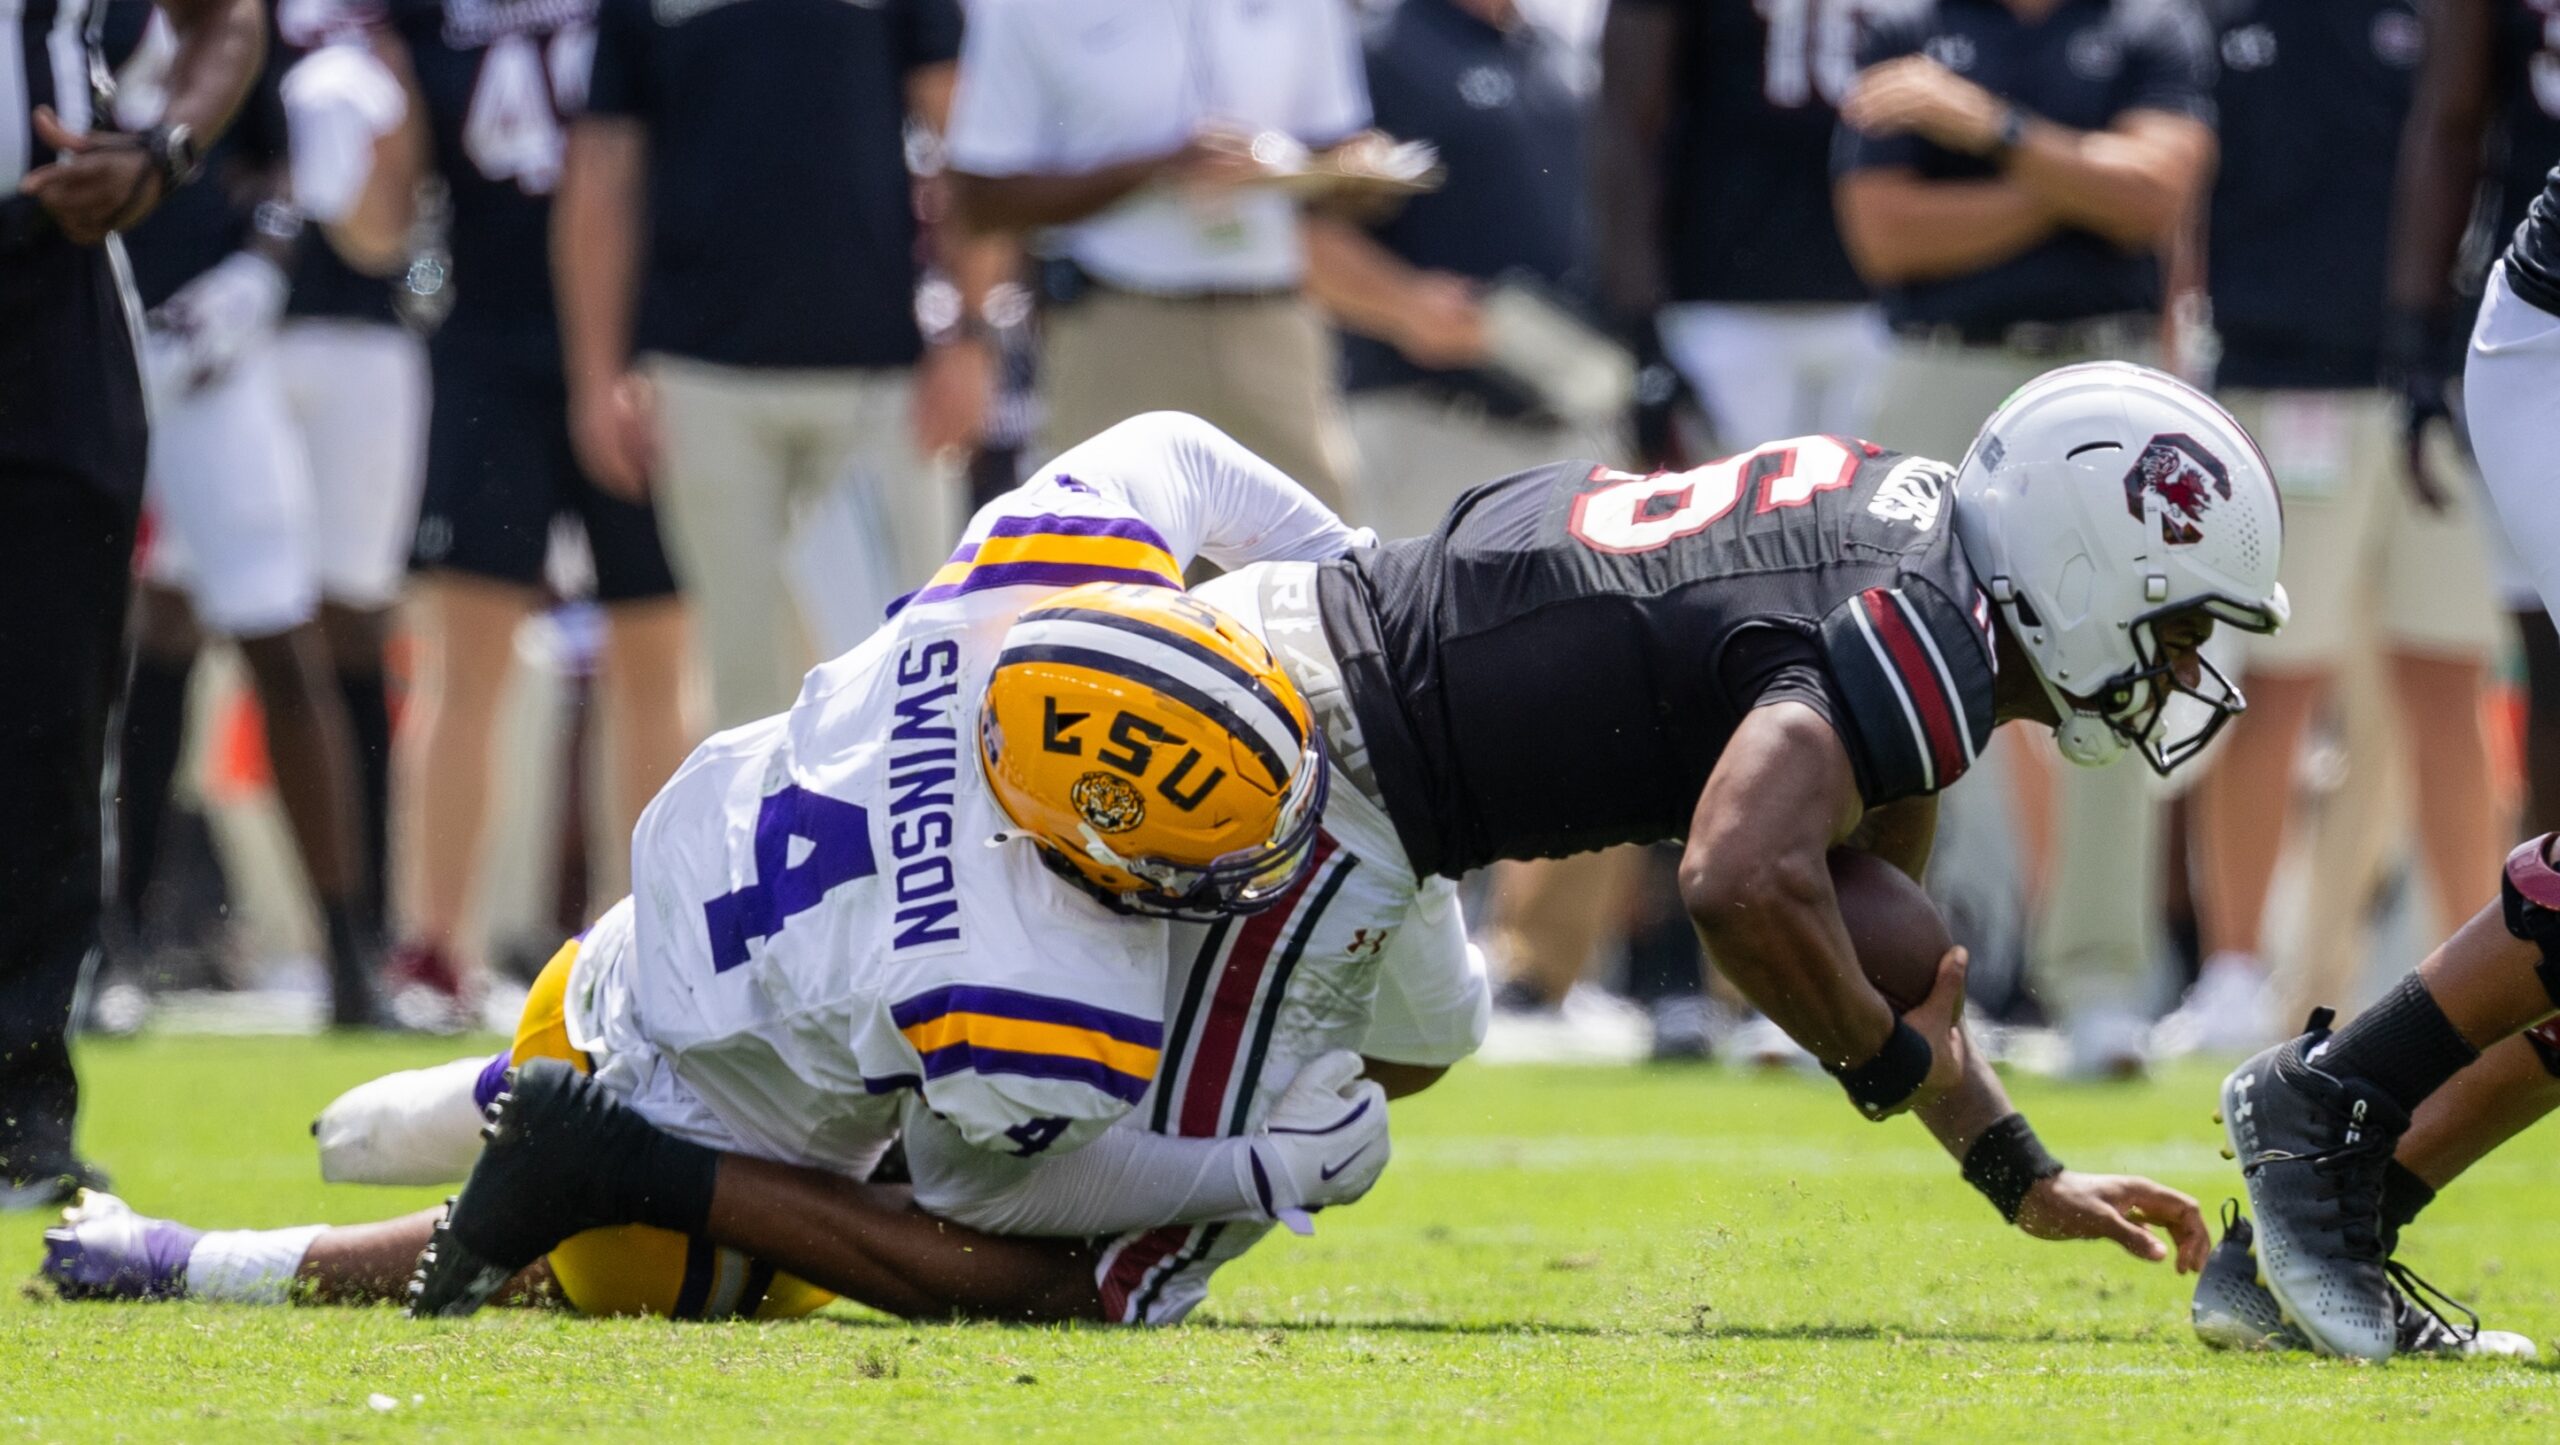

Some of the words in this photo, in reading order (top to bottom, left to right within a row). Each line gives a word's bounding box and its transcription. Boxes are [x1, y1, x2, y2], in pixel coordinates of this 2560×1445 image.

[889, 638, 961, 952] SWINSON
[1043, 696, 1228, 812] LSU
[703, 784, 878, 975] 4
